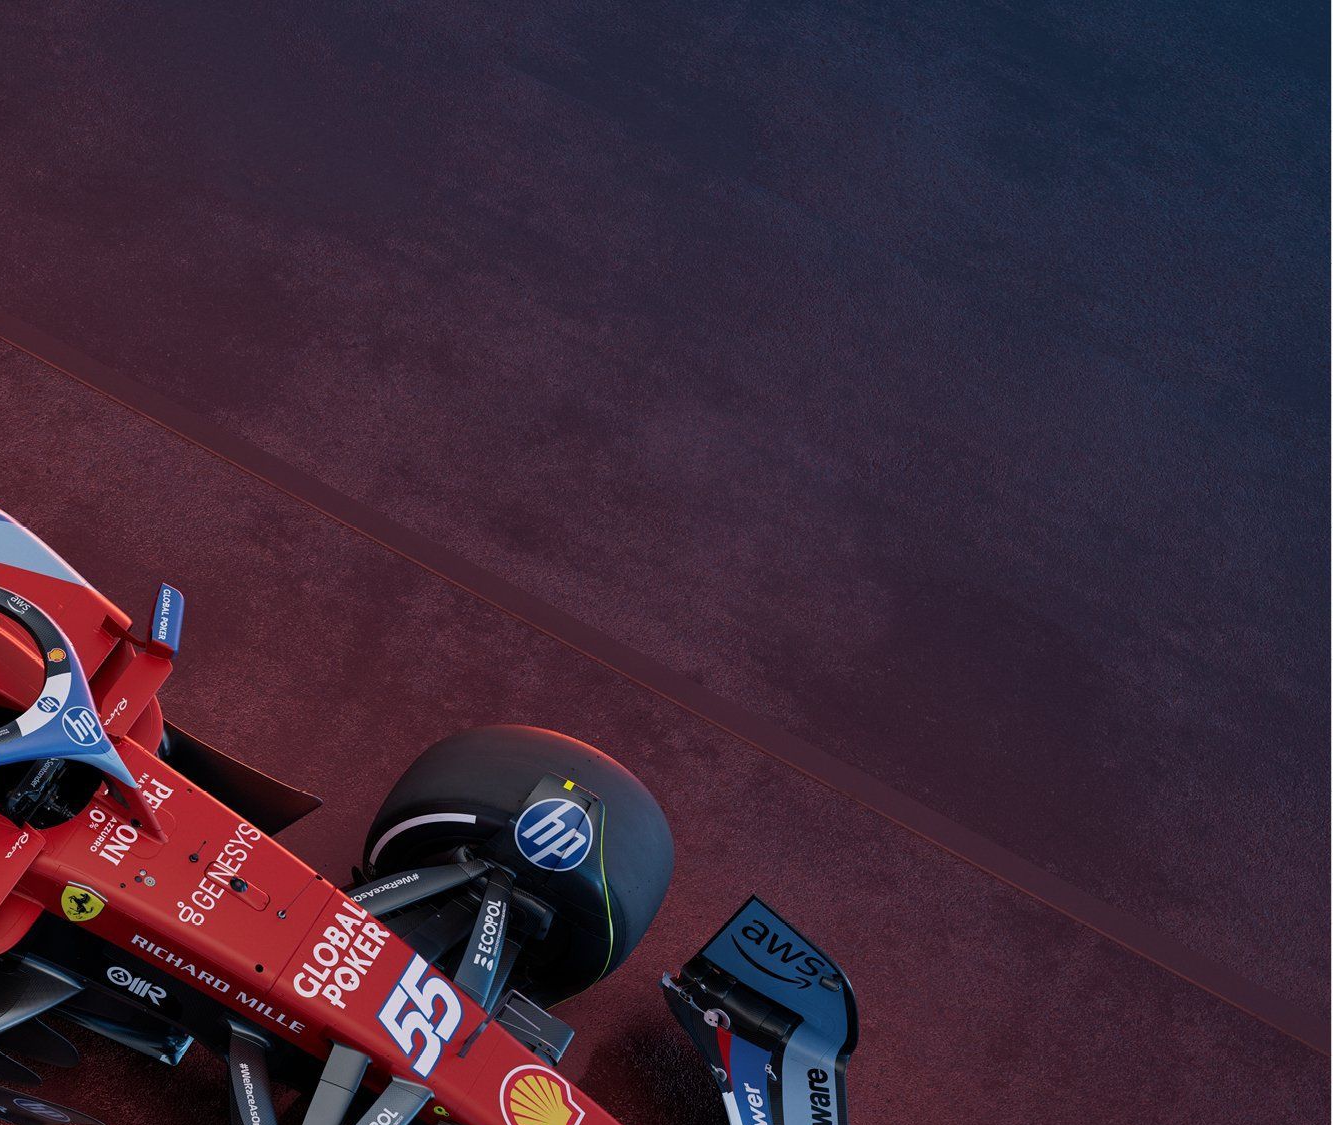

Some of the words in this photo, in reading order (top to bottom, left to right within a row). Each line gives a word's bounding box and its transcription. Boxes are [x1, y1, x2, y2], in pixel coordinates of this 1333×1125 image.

[11, 595, 31, 611] aws
[161, 588, 171, 617] GLOBAL
[157, 619, 169, 640] POKER
[64, 707, 99, 745] hp
[103, 697, 128, 726] Riva
[31, 758, 53, 788] Santander
[5, 832, 29, 858] Riva
[90, 816, 117, 852] AZZURRO
[518, 799, 590, 870] hp
[191, 823, 261, 912] GENESYS
[350, 873, 420, 903] #WeRaceAsO
[478, 899, 501, 955] ECOPOL
[293, 901, 368, 999] GLOBAL
[321, 923, 390, 1010] POKER
[742, 919, 825, 976] aws
[131, 933, 231, 993] RICHARD
[235, 991, 306, 1034] MILLE
[375, 949, 464, 1080] 55
